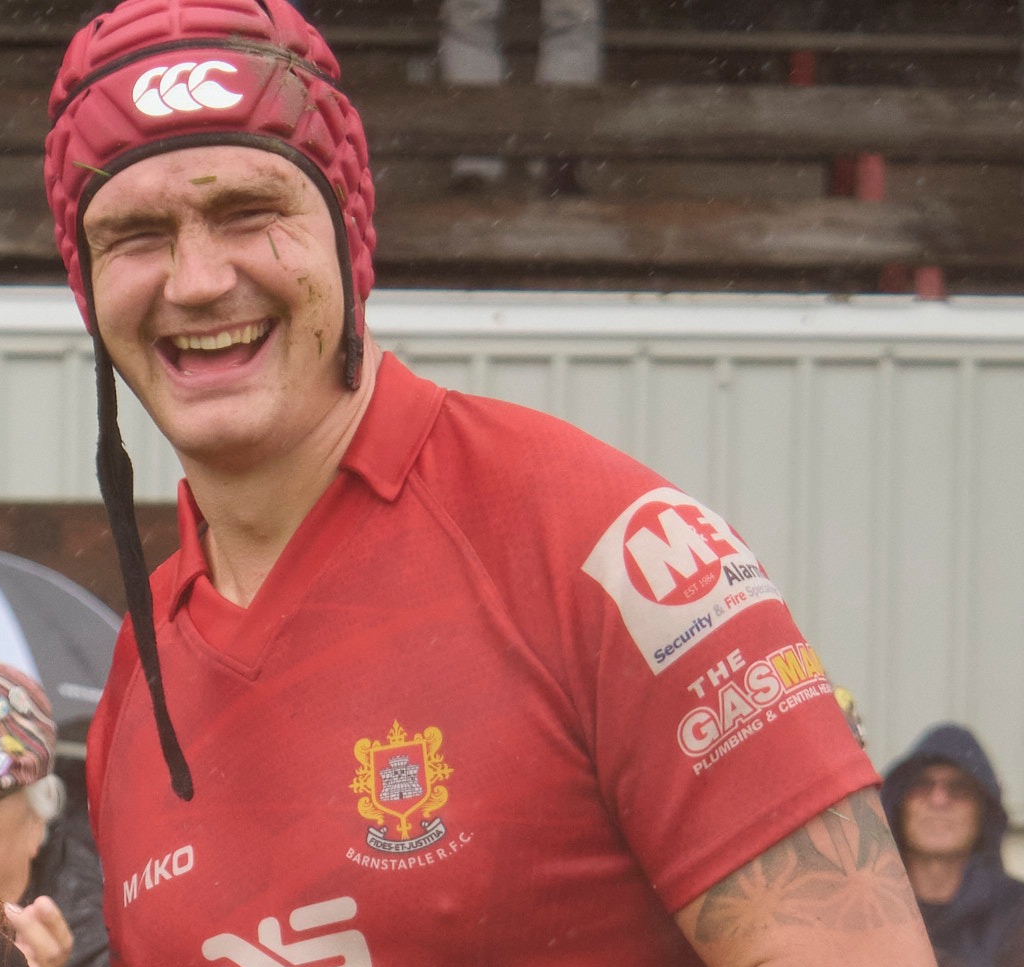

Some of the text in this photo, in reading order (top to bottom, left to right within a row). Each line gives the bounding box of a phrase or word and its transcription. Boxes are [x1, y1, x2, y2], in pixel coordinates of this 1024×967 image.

[683, 585, 699, 599] EST
[653, 612, 713, 664] Security
[713, 603, 726, 617] &
[724, 591, 747, 609] Fire
[687, 648, 746, 699] THE
[692, 718, 763, 776] PLUMBING
[765, 709, 777, 722] &
[778, 686, 820, 713] CENTRAL
[345, 847, 435, 871] BARNSTAPLE
